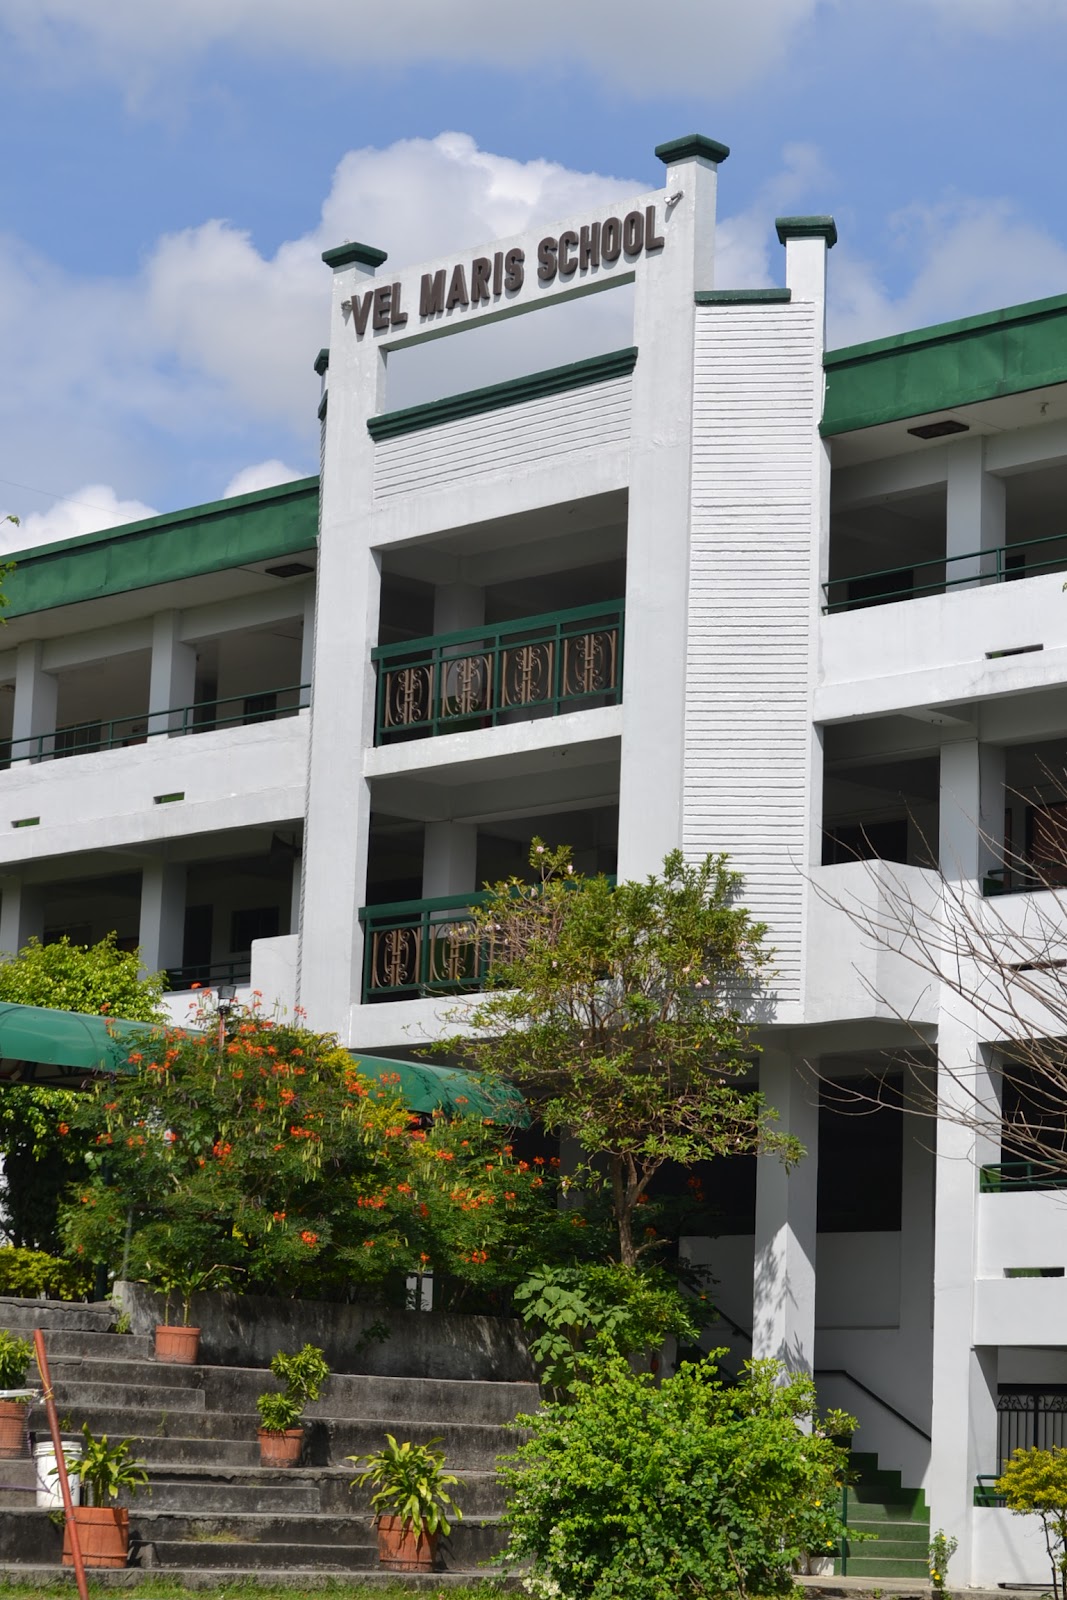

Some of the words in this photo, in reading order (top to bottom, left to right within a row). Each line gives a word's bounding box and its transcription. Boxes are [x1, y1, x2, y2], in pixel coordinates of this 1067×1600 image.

[351, 282, 408, 335] VEL
[419, 248, 525, 317] MARIS
[537, 205, 665, 281] SCHOOL
